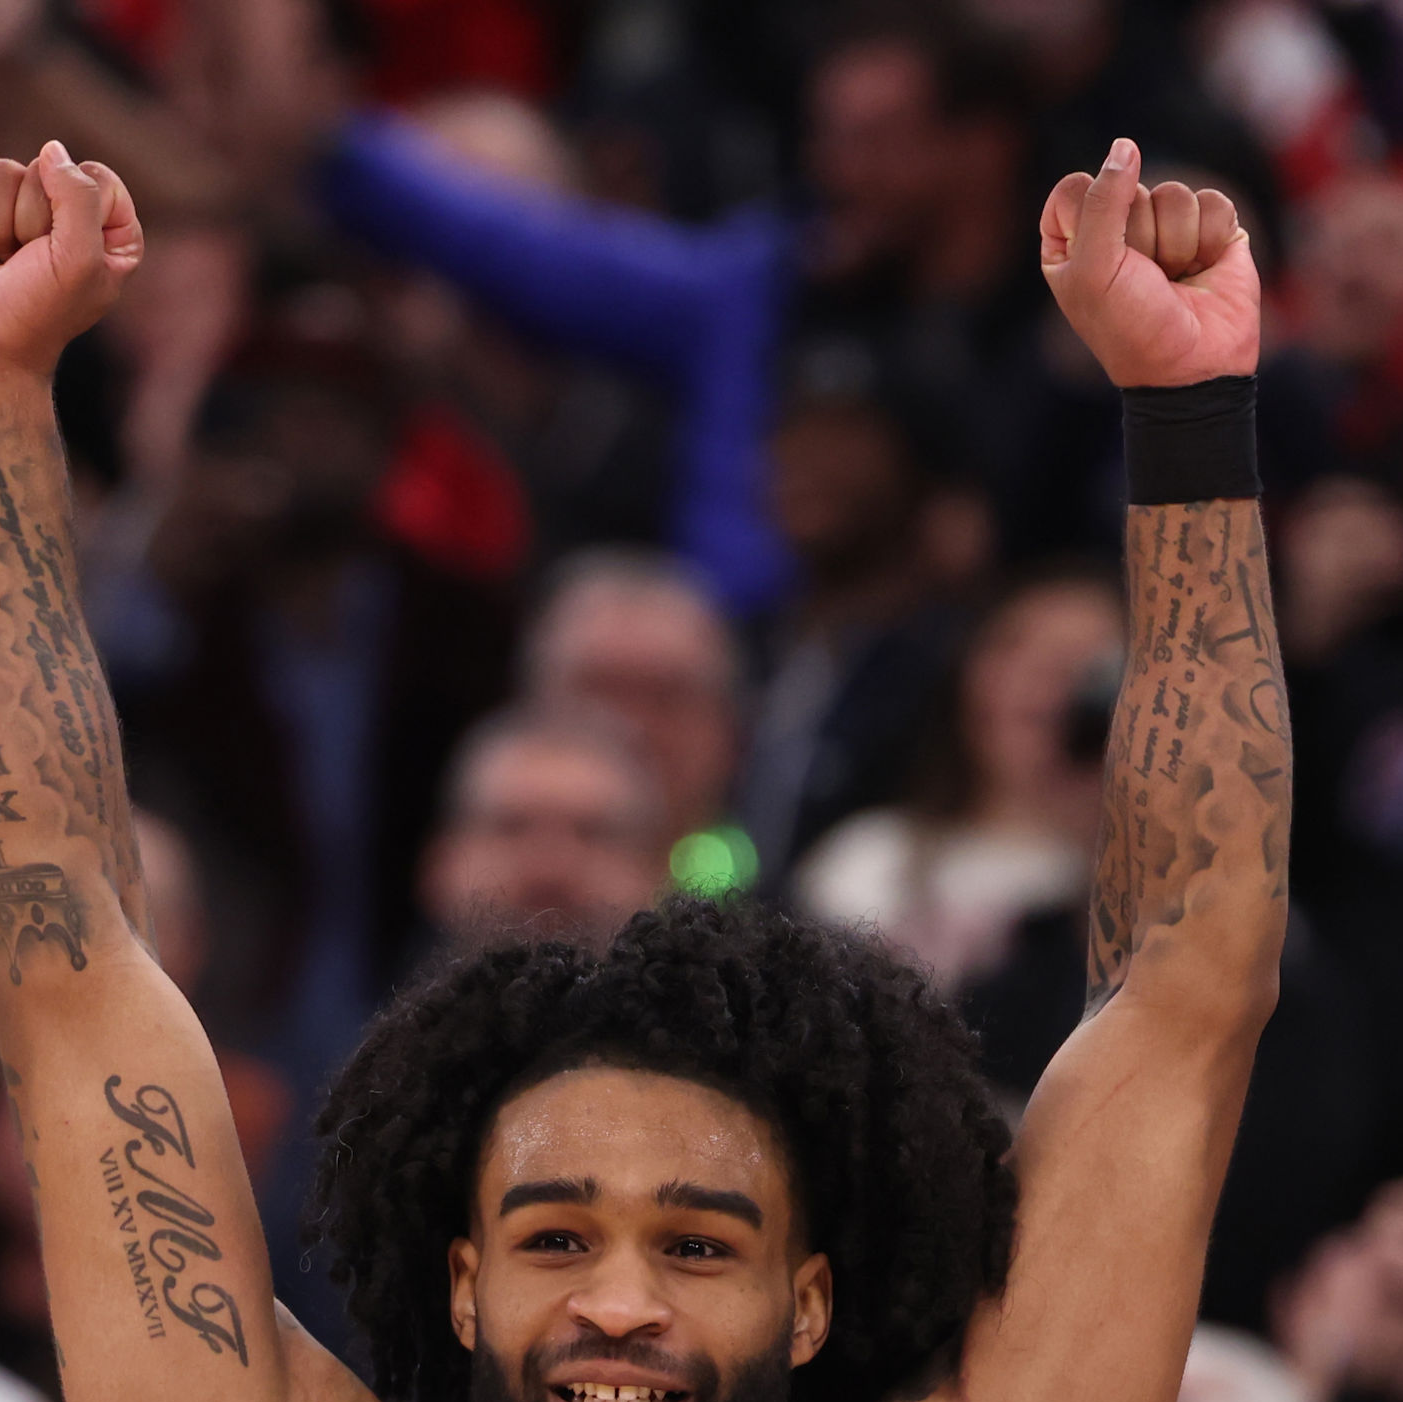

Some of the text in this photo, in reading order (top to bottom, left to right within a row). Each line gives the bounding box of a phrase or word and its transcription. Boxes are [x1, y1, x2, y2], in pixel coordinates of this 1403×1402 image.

[99, 1147, 166, 1339] VIII XV MMXVII
